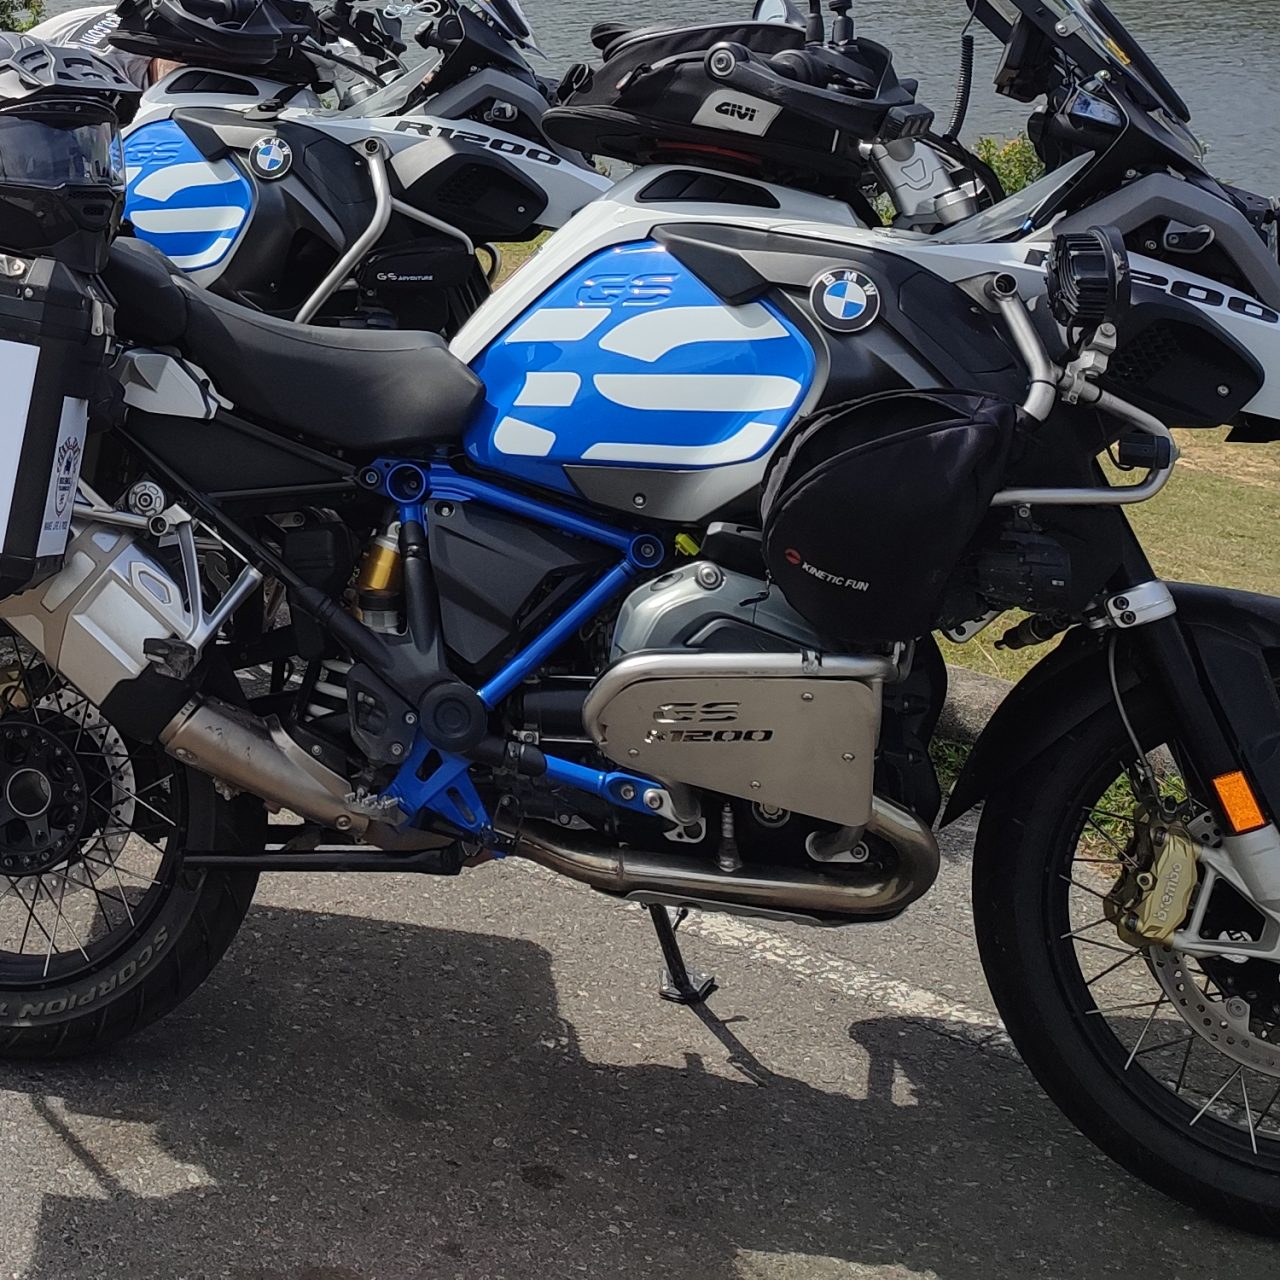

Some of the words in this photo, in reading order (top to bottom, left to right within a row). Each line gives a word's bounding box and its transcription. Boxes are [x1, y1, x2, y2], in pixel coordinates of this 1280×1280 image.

[714, 101, 757, 122] GIVI
[125, 141, 184, 165] GS
[256, 138, 291, 155] BMW
[394, 120, 562, 166] R1200
[376, 272, 398, 281] GS
[576, 272, 680, 307] GS
[821, 270, 877, 296] BMW
[801, 561, 845, 586] KINETIC
[844, 578, 870, 592] FUN
[652, 701, 742, 724] GS
[1152, 863, 1182, 922] brembo
[19, 925, 169, 1019] SCORPION
